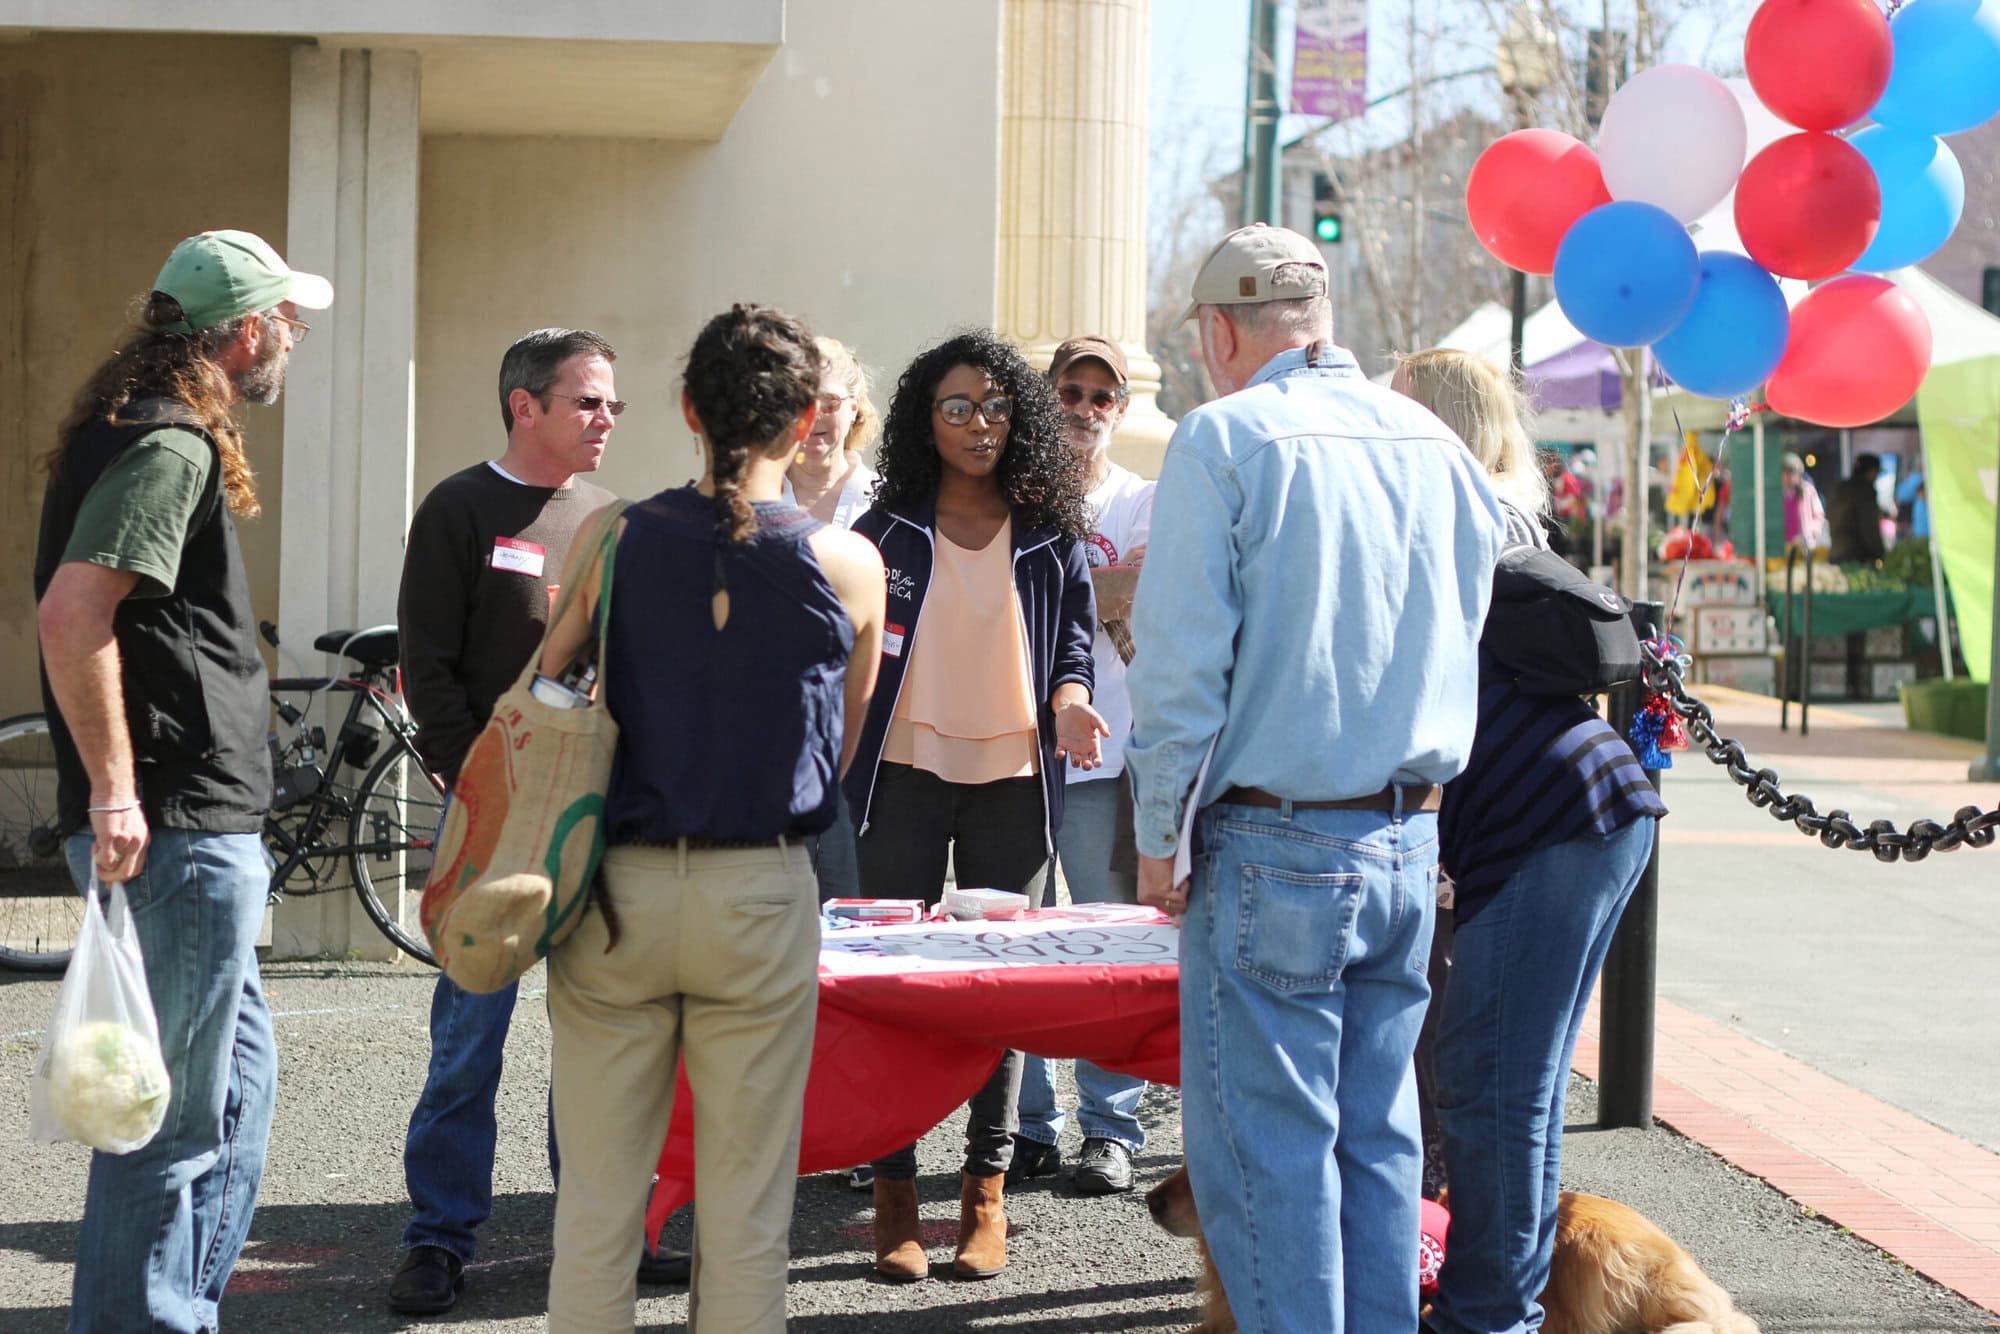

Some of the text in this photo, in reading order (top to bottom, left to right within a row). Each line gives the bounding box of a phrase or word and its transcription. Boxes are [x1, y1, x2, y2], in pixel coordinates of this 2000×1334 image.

[884, 567, 901, 580] ODE
[873, 930, 1153, 945] ACROSS
[944, 942, 1170, 958] CODE
